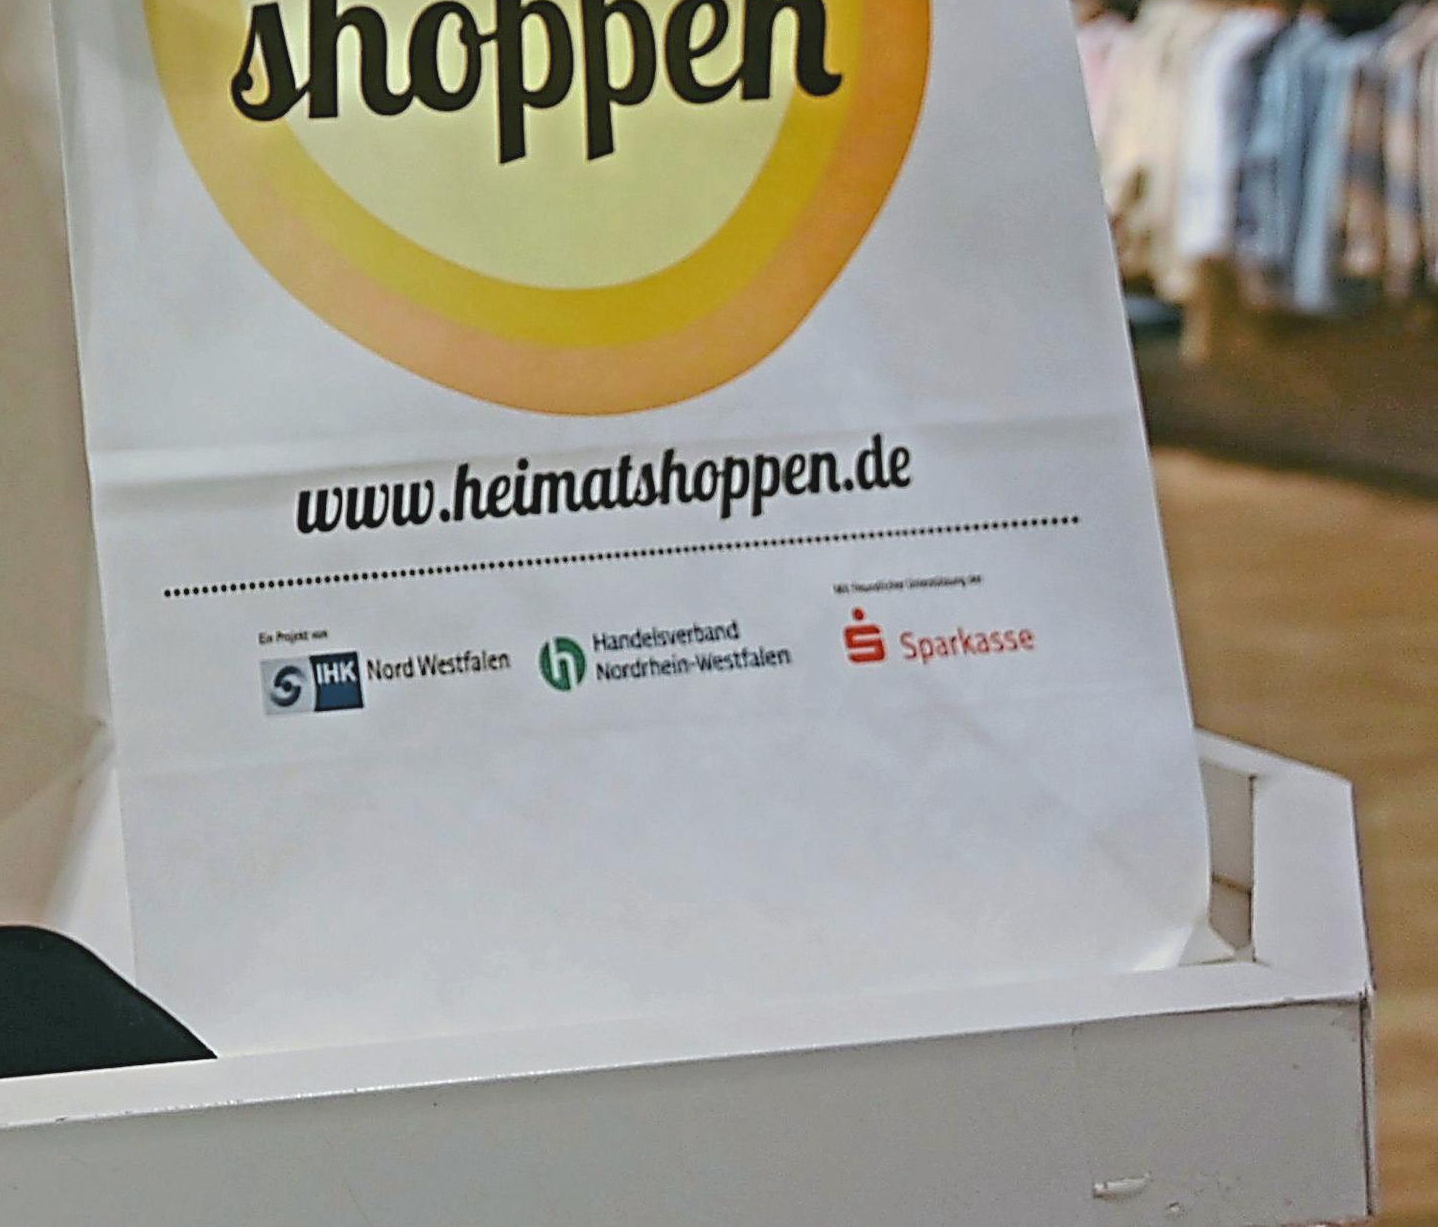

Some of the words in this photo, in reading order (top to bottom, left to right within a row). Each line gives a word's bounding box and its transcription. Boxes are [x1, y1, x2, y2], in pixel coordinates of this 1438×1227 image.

[295, 434, 912, 532] www.heimatshoppen.de
[593, 619, 741, 652] Handelsverband
[899, 627, 1035, 664] Sparkasse
[316, 660, 358, 685] IHK
[367, 654, 415, 681] Nord
[417, 649, 511, 676] Westfalen
[596, 644, 792, 682] Nordrhein-Westfalen
